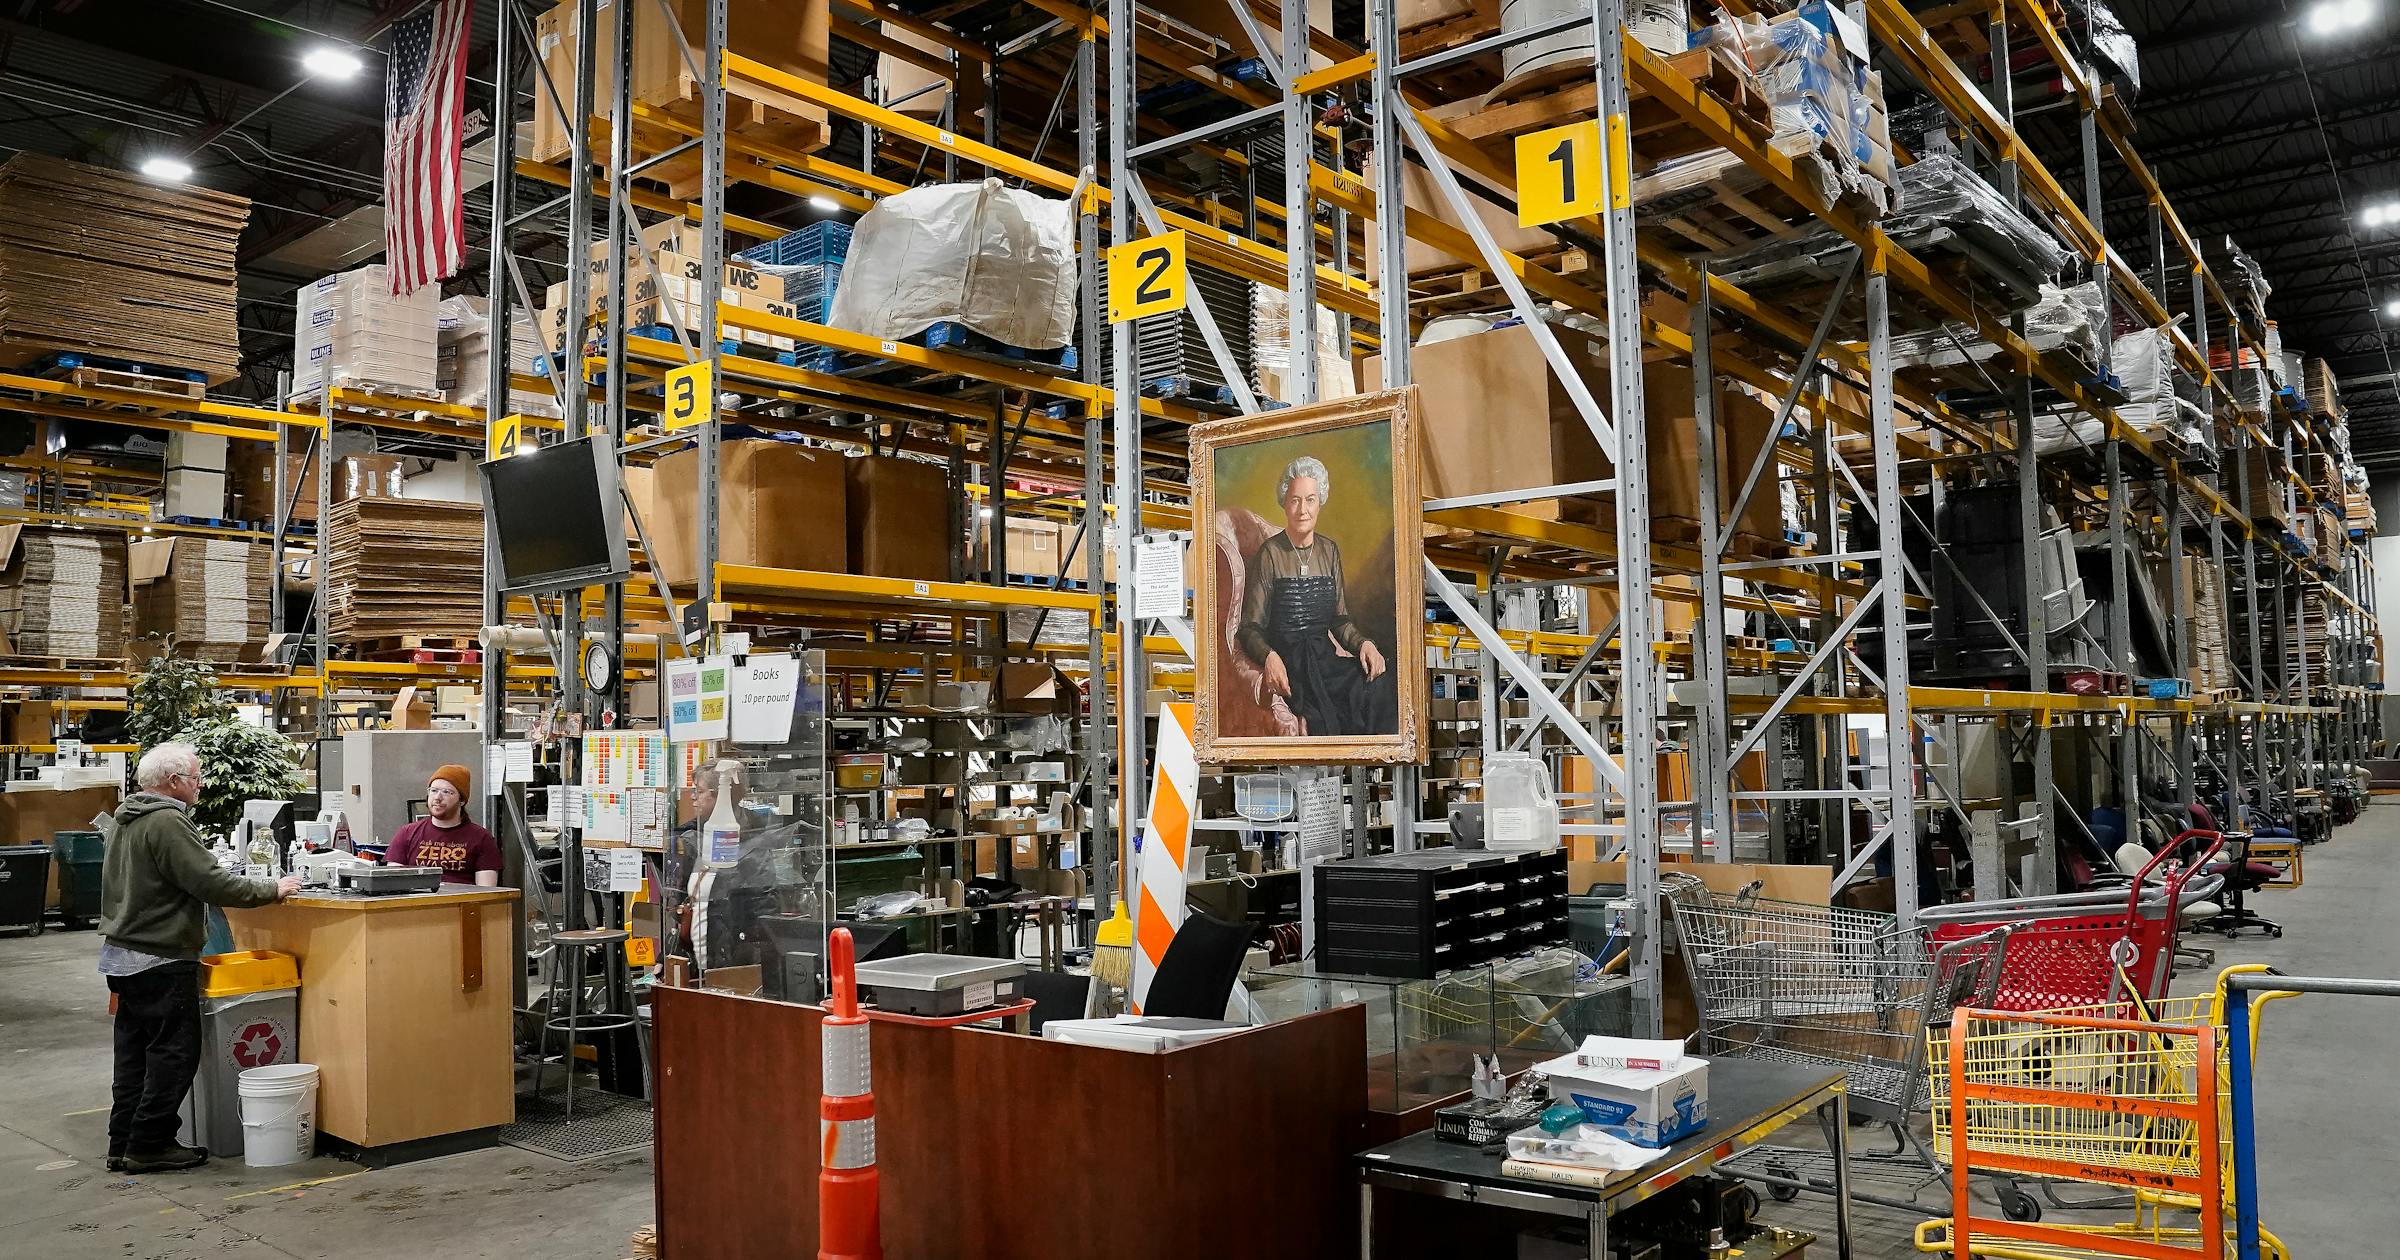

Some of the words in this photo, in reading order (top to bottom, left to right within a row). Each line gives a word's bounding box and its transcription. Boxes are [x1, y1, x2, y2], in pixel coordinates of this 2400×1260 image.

[1548, 138, 1575, 204] 1
[1136, 247, 1171, 305] 2
[311, 346, 332, 359] ULINE
[673, 376, 694, 419] 3
[500, 425, 515, 455] 4
[915, 584, 928, 593] 3A1
[753, 668, 779, 680] Books
[753, 695, 765, 705] per
[766, 692, 790, 705] pound
[416, 846, 467, 860] ZERO
[415, 860, 467, 871] WASTE
[1591, 1056, 1624, 1068] UNIX
[1583, 1100, 1615, 1113] STANDARD
[1437, 1118, 1466, 1136] LINUX
[1469, 1119, 1486, 1128] COM
[1468, 1127, 1499, 1138] COMMAN
[1468, 1133, 1490, 1143] REFER
